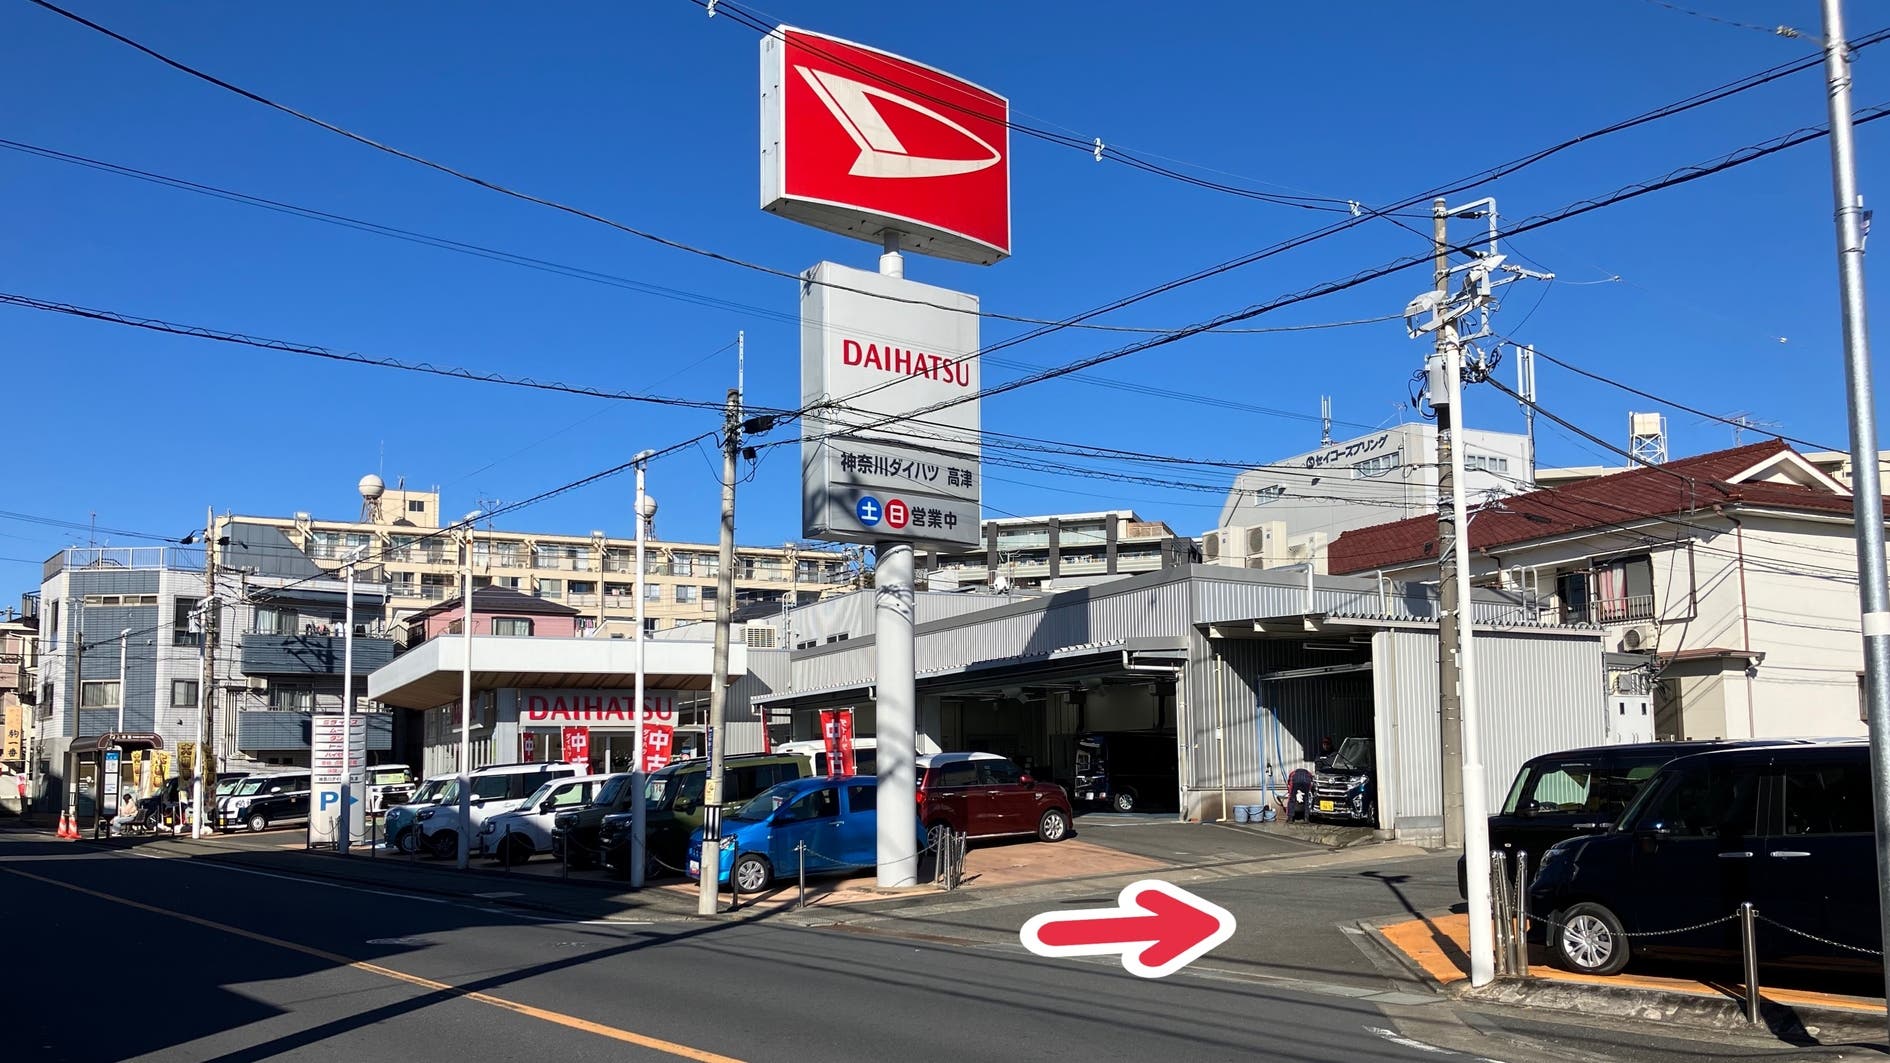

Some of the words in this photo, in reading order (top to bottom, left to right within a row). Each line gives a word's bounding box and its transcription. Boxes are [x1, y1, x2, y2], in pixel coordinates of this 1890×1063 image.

[843, 339, 969, 387] DAIHATSU
[840, 452, 939, 482] 神奈川ダイハツ
[947, 466, 973, 489] 高津
[528, 696, 673, 721] DAIHATSU
[320, 791, 339, 811] P
